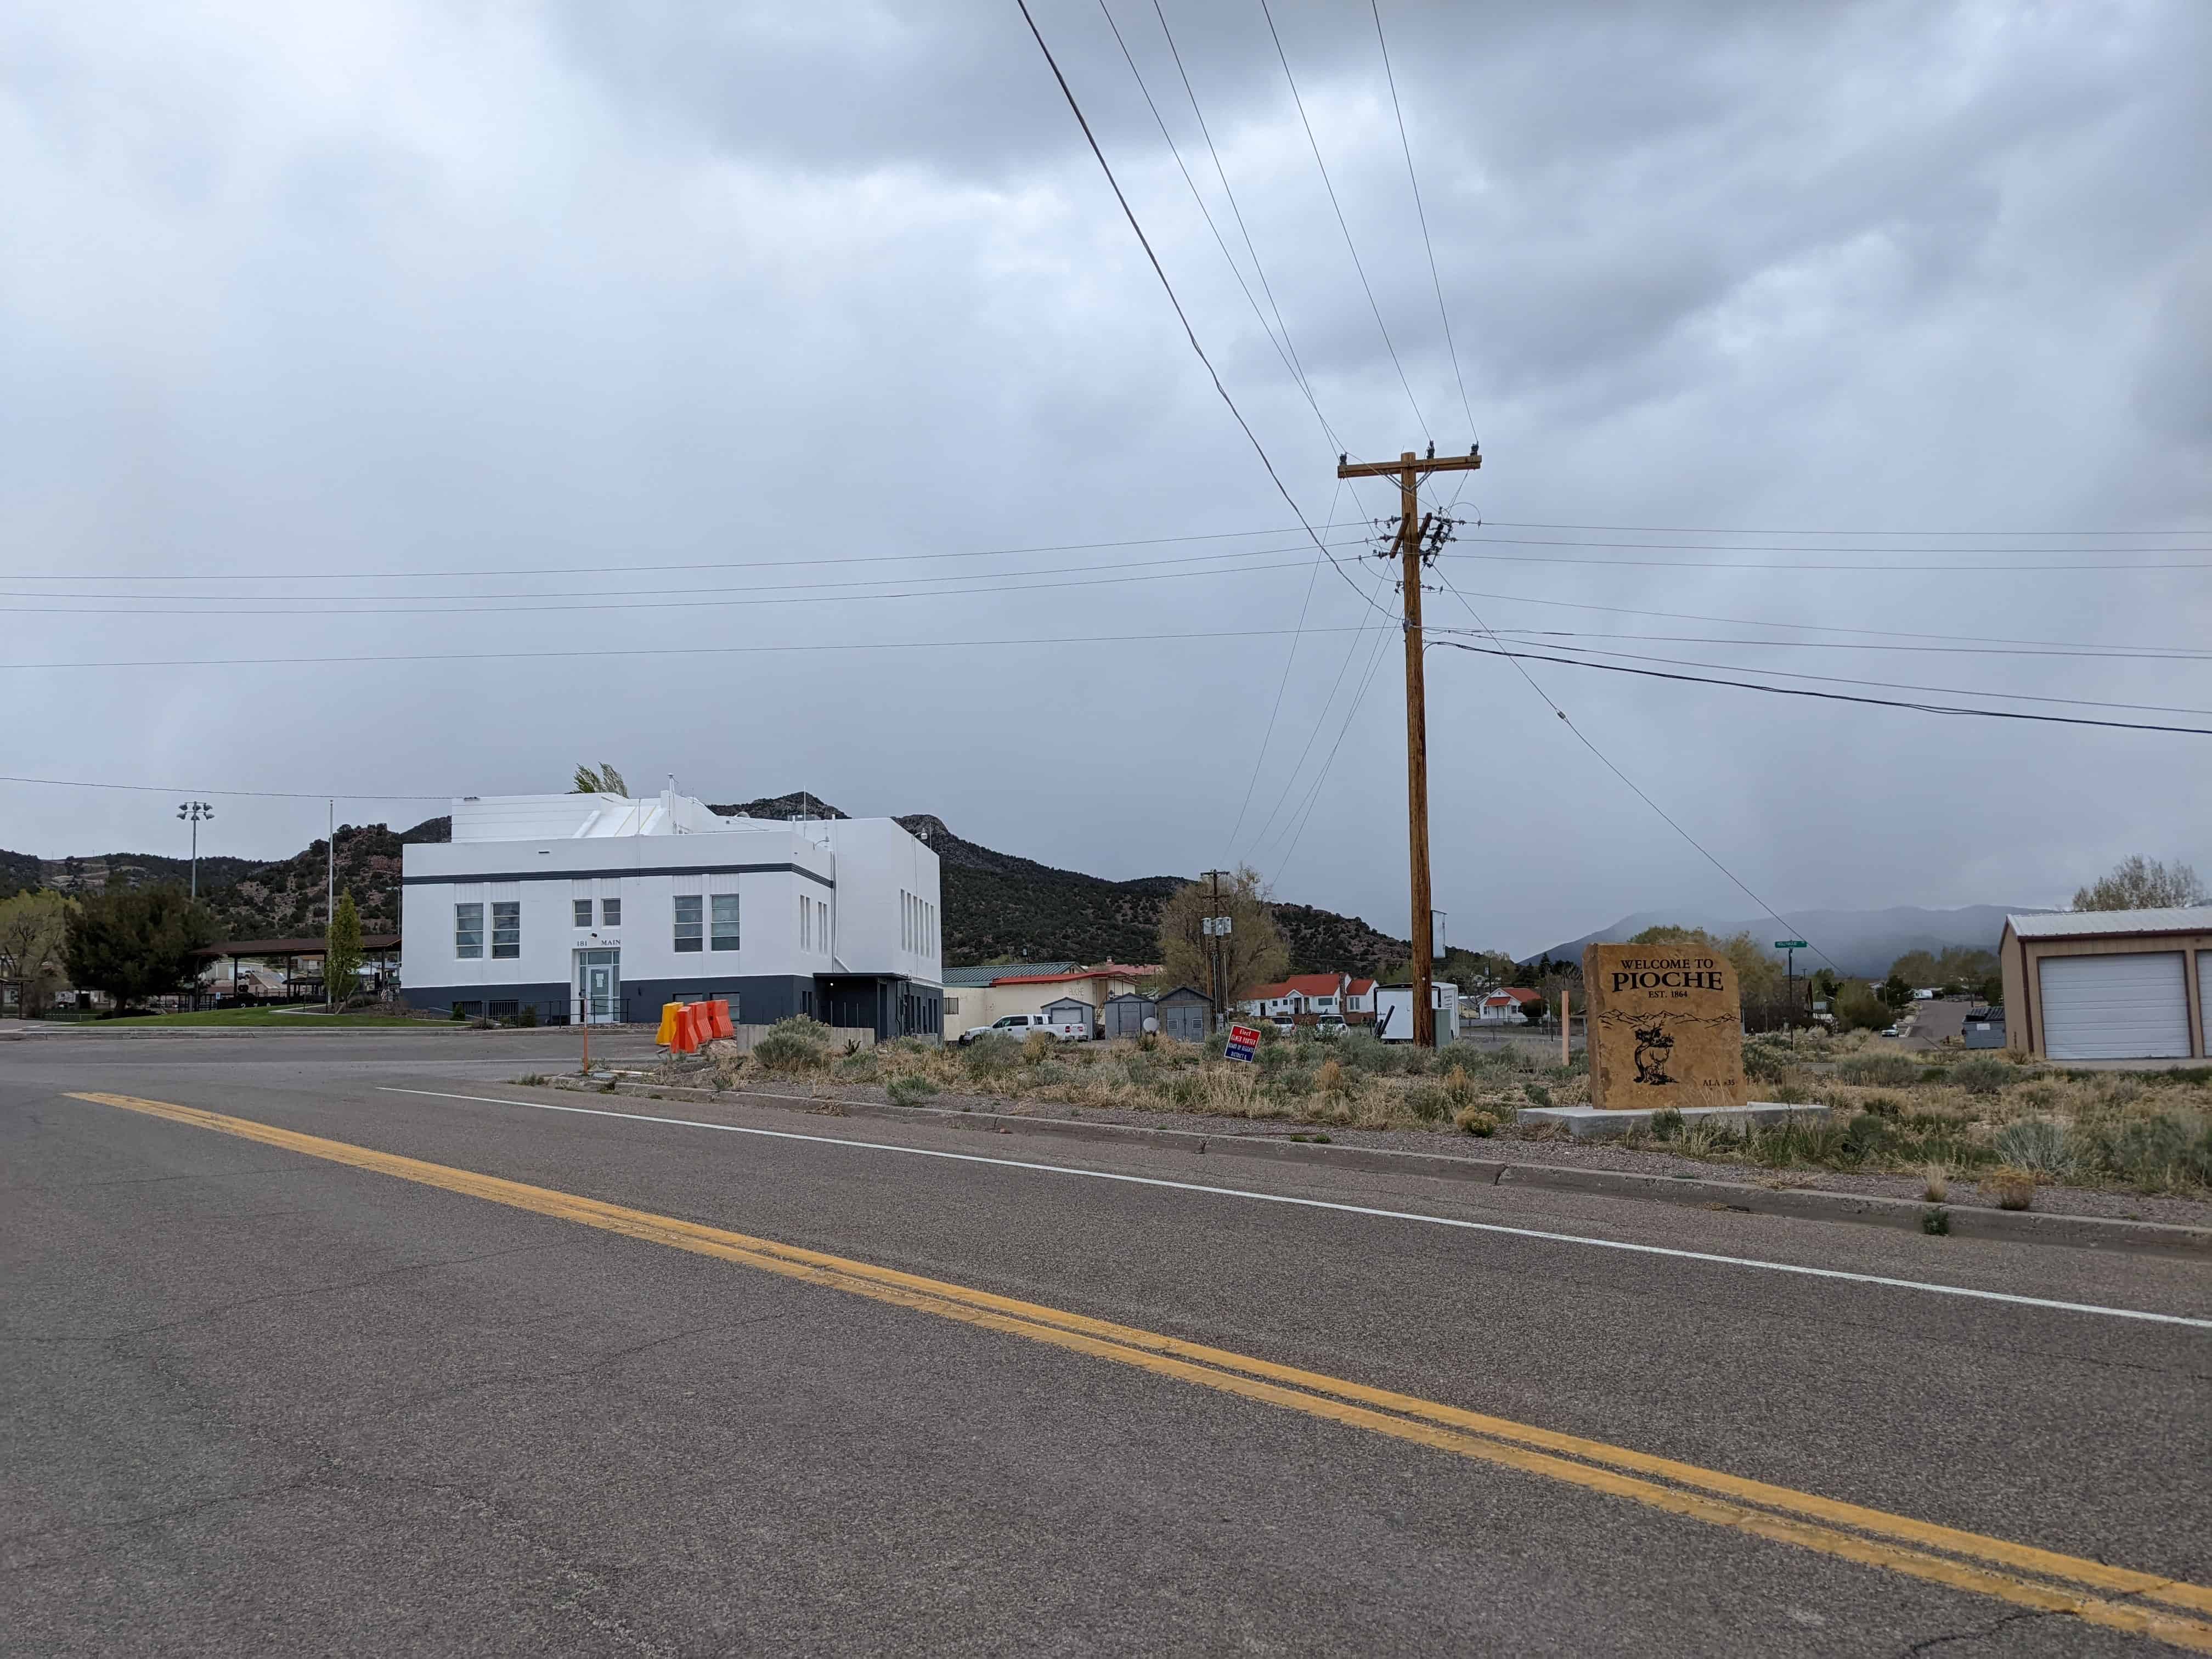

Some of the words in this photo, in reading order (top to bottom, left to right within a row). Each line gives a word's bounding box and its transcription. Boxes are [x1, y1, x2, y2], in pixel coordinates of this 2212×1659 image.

[1621, 960, 1690, 970] WELCOME
[1694, 959, 1714, 969] TO
[1611, 971, 1724, 992] PIOCHE
